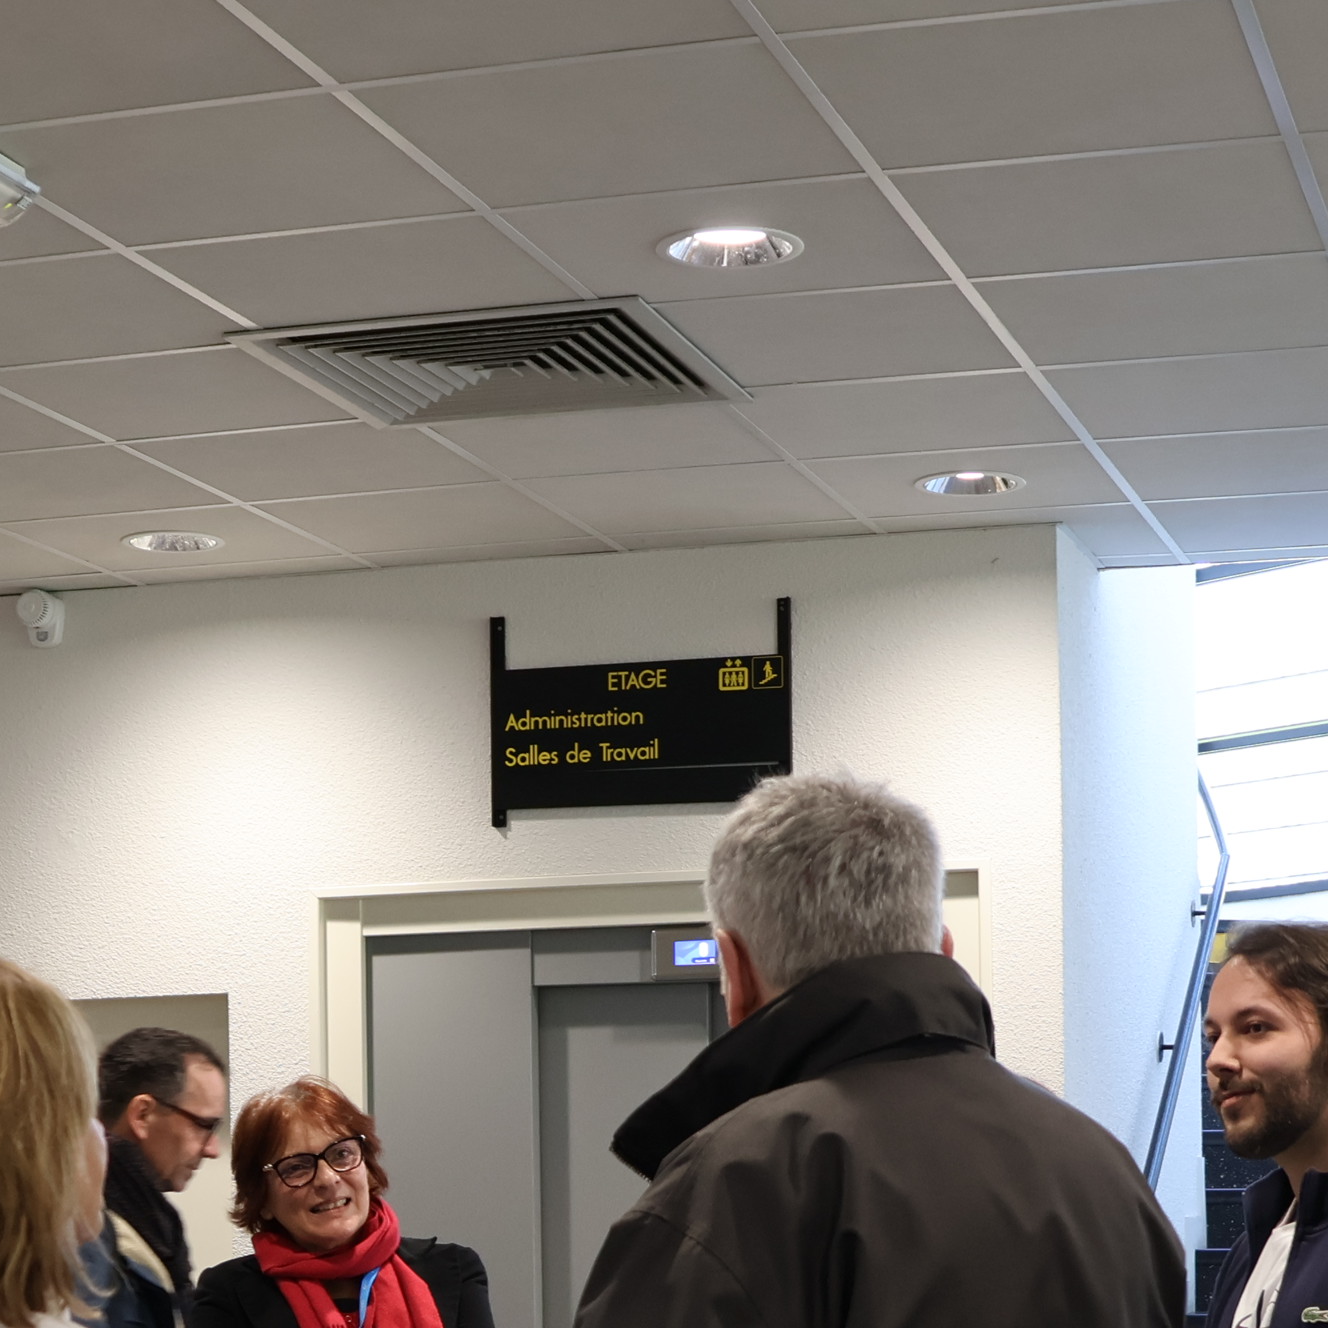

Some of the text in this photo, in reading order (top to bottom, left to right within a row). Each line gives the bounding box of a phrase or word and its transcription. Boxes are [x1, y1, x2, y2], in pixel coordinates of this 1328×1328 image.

[607, 669, 668, 691] ETAGE
[504, 707, 644, 732] Administration
[504, 738, 659, 767] Salles de Travail
